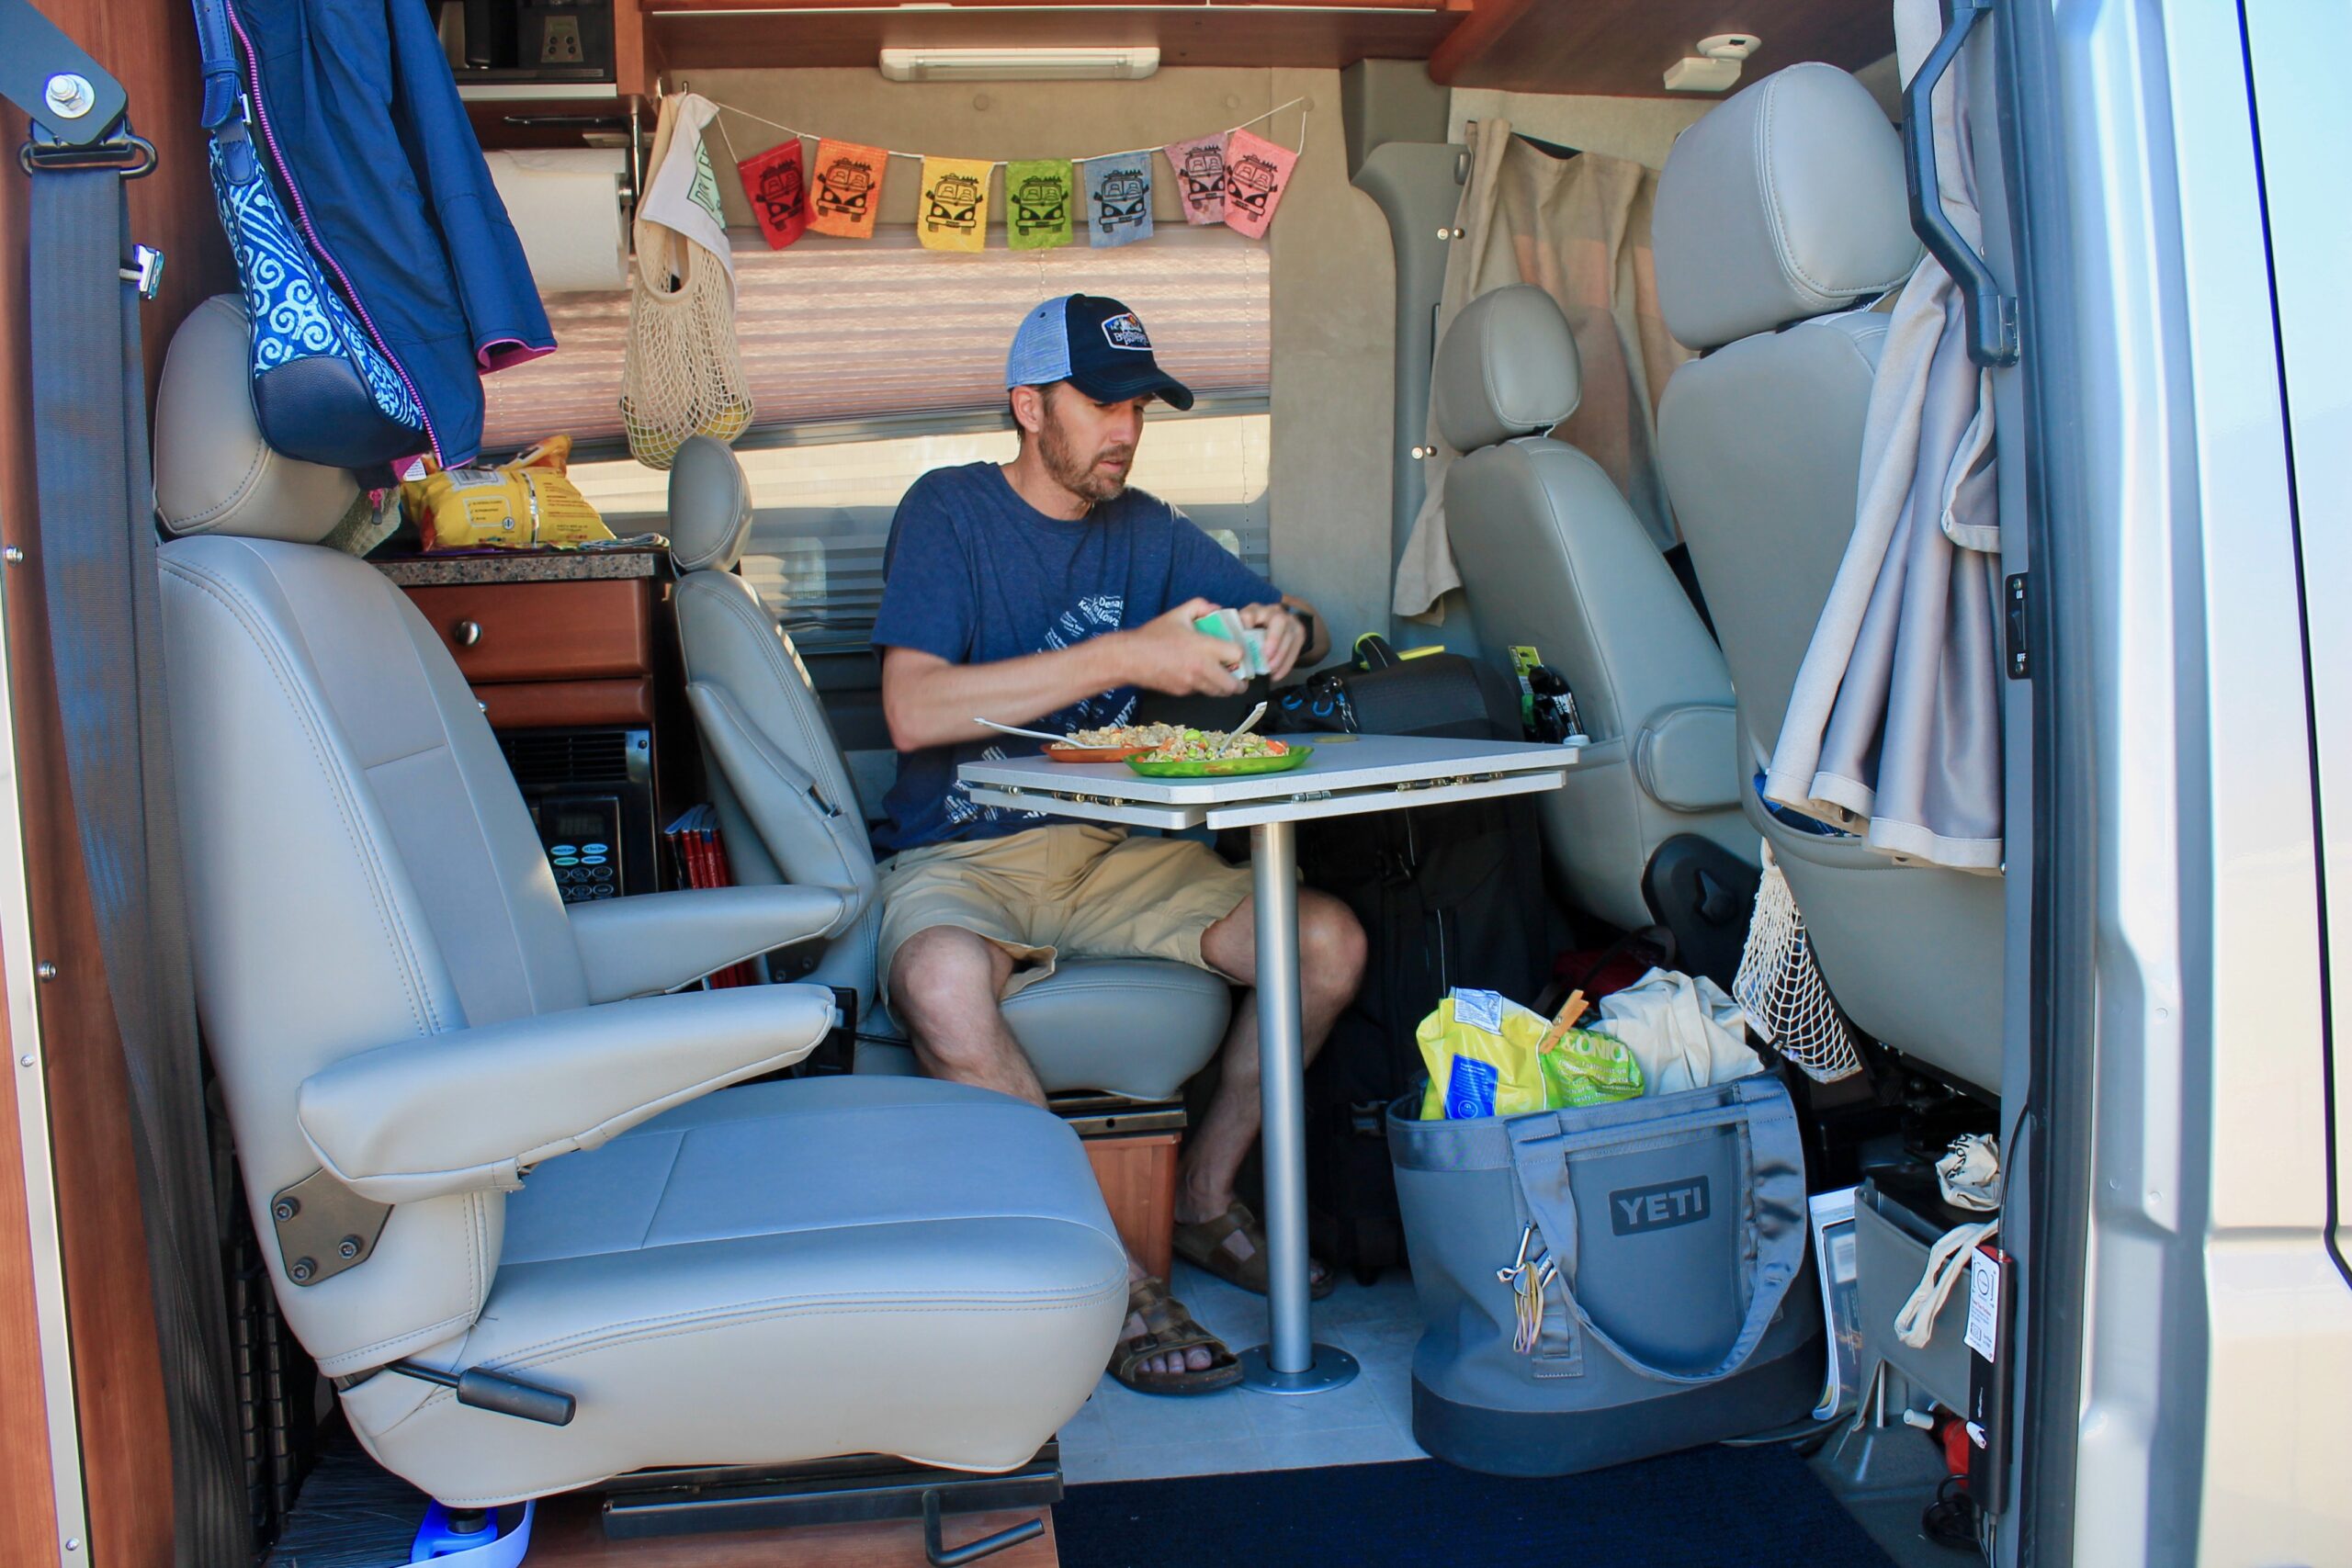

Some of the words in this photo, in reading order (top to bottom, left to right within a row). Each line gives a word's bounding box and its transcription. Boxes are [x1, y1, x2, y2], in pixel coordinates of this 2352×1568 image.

[2017, 653, 2026, 662] OFF
[1576, 1032, 1628, 1062] ONIO
[1617, 1186, 1702, 1225] YETI
